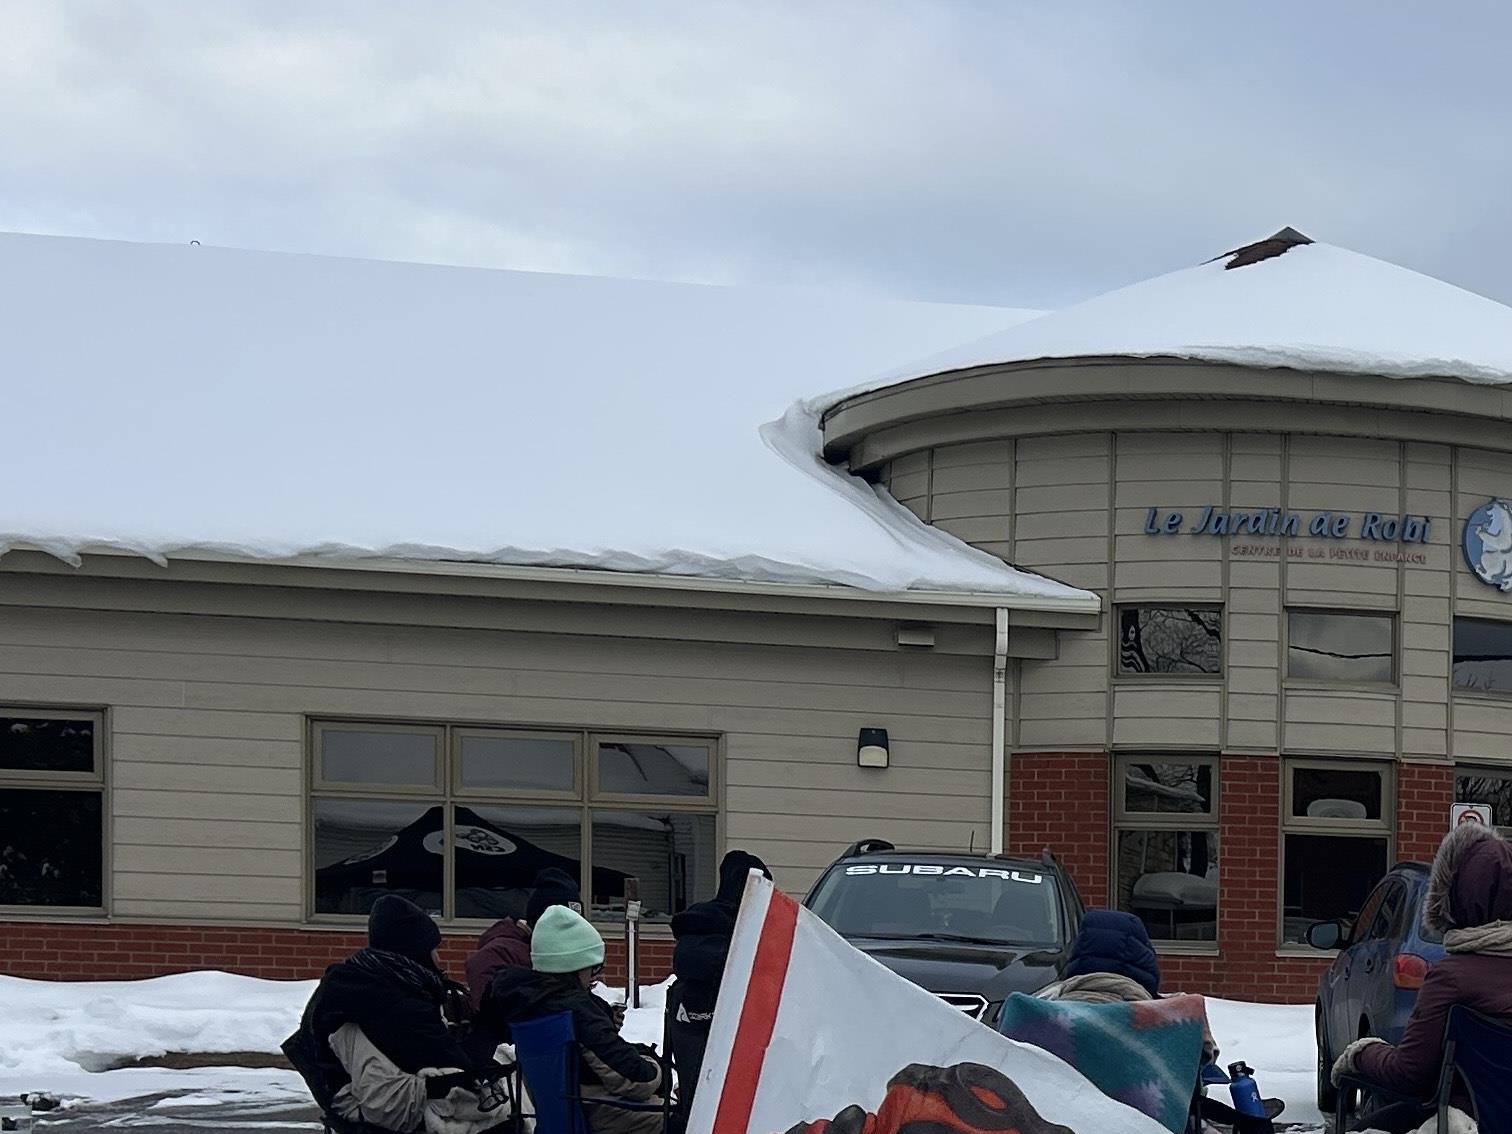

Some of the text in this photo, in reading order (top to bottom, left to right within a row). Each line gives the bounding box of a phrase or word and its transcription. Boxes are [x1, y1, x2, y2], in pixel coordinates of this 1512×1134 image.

[1144, 505, 1432, 544] Le Jardin de Robi
[1286, 547, 1303, 558] DE
[1374, 551, 1427, 564] ENFANCE
[845, 864, 1043, 885] SUBARU
